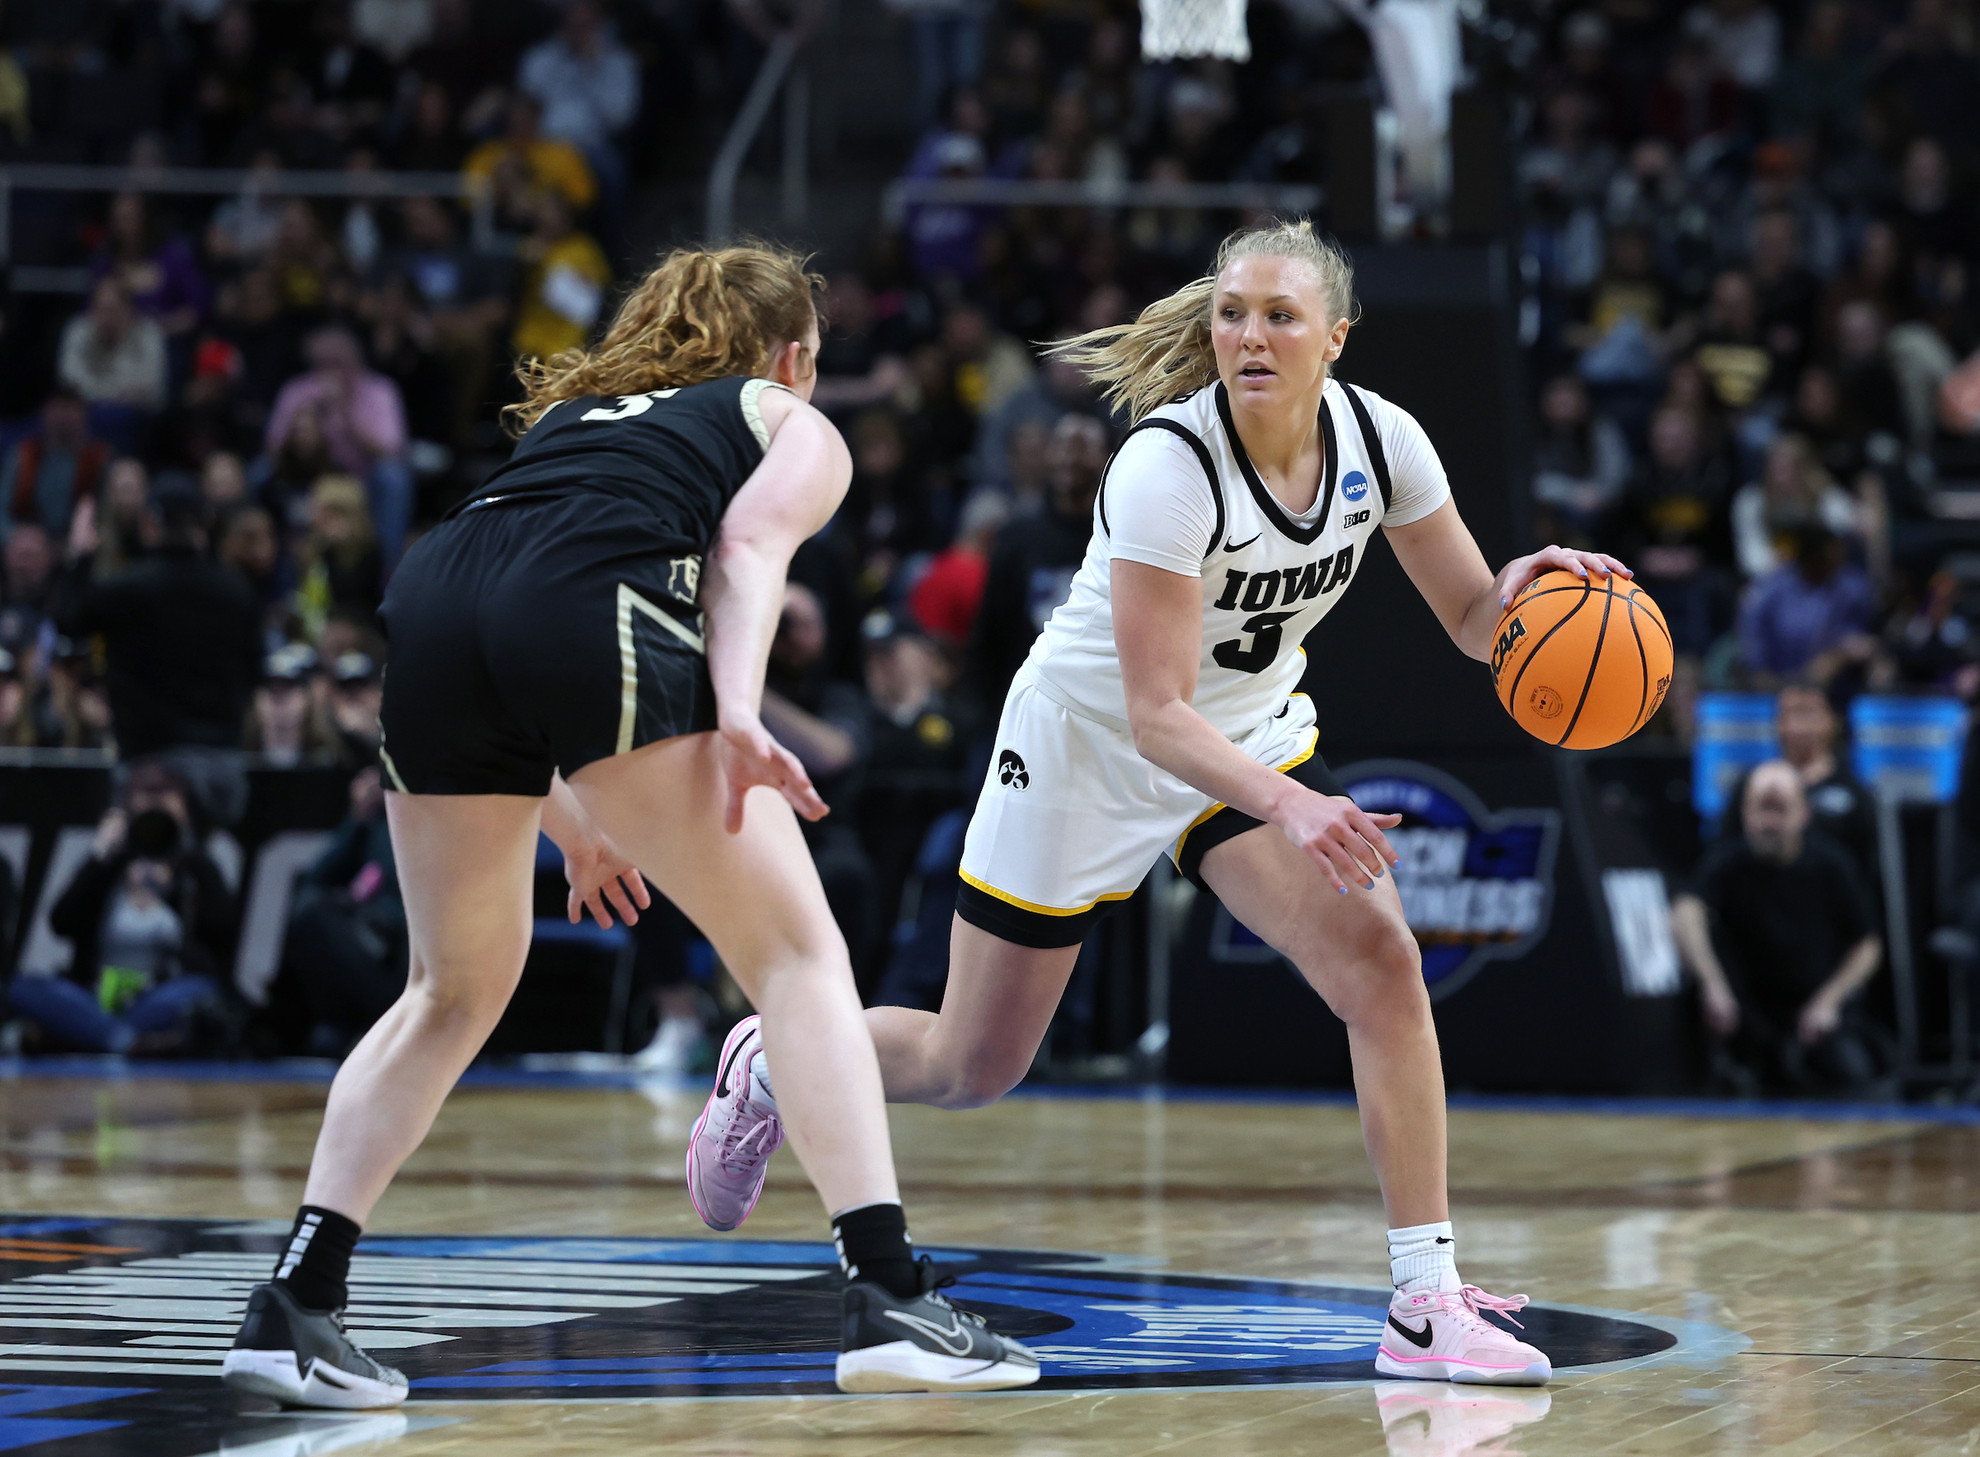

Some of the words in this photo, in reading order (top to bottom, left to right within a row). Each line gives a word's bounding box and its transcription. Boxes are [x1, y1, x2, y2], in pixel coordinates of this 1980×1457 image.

[1345, 482, 1367, 496] NCAA
[1213, 543, 1354, 612] IOWA
[1212, 606, 1309, 675] 3
